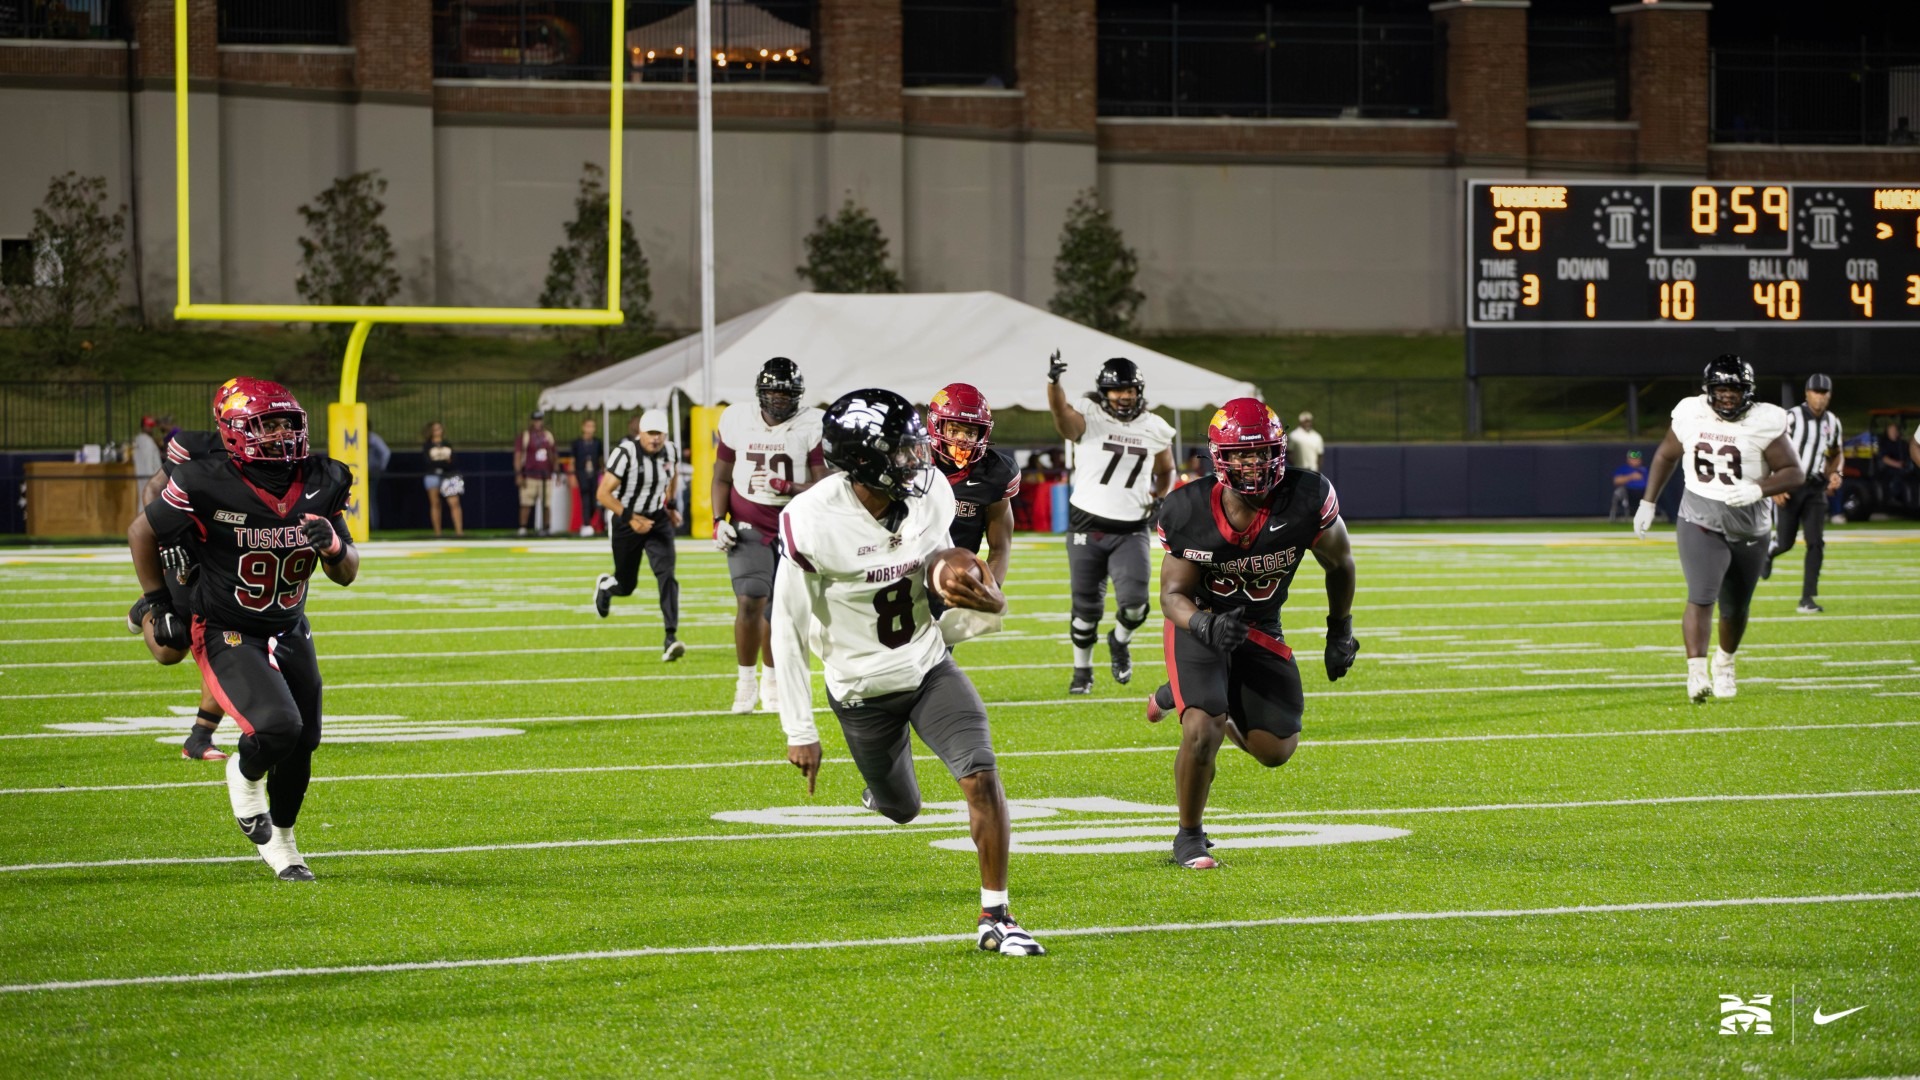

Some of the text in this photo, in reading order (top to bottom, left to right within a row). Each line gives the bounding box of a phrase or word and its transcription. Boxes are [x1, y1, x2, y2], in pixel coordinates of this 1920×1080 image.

[1692, 186, 1788, 233] 8:59
[1493, 211, 1541, 250] 20
[1480, 259, 1518, 278] TIME
[1557, 258, 1609, 280] DOWN
[1646, 258, 1696, 280] TO GO
[1748, 258, 1809, 280] BALL ON
[1846, 258, 1879, 281] QTR
[1477, 280, 1520, 300] OUTS
[1522, 274, 1540, 306] 3
[1586, 282, 1596, 318] 1
[1660, 280, 1695, 320] 10
[1753, 280, 1800, 320] 40
[1851, 282, 1873, 318] 4
[1478, 302, 1517, 320] LEFT
[1100, 442, 1148, 489] 77
[1694, 442, 1743, 485] 63
[234, 526, 307, 549] TUSKEG
[234, 547, 317, 612] 99
[872, 576, 916, 649] 8
